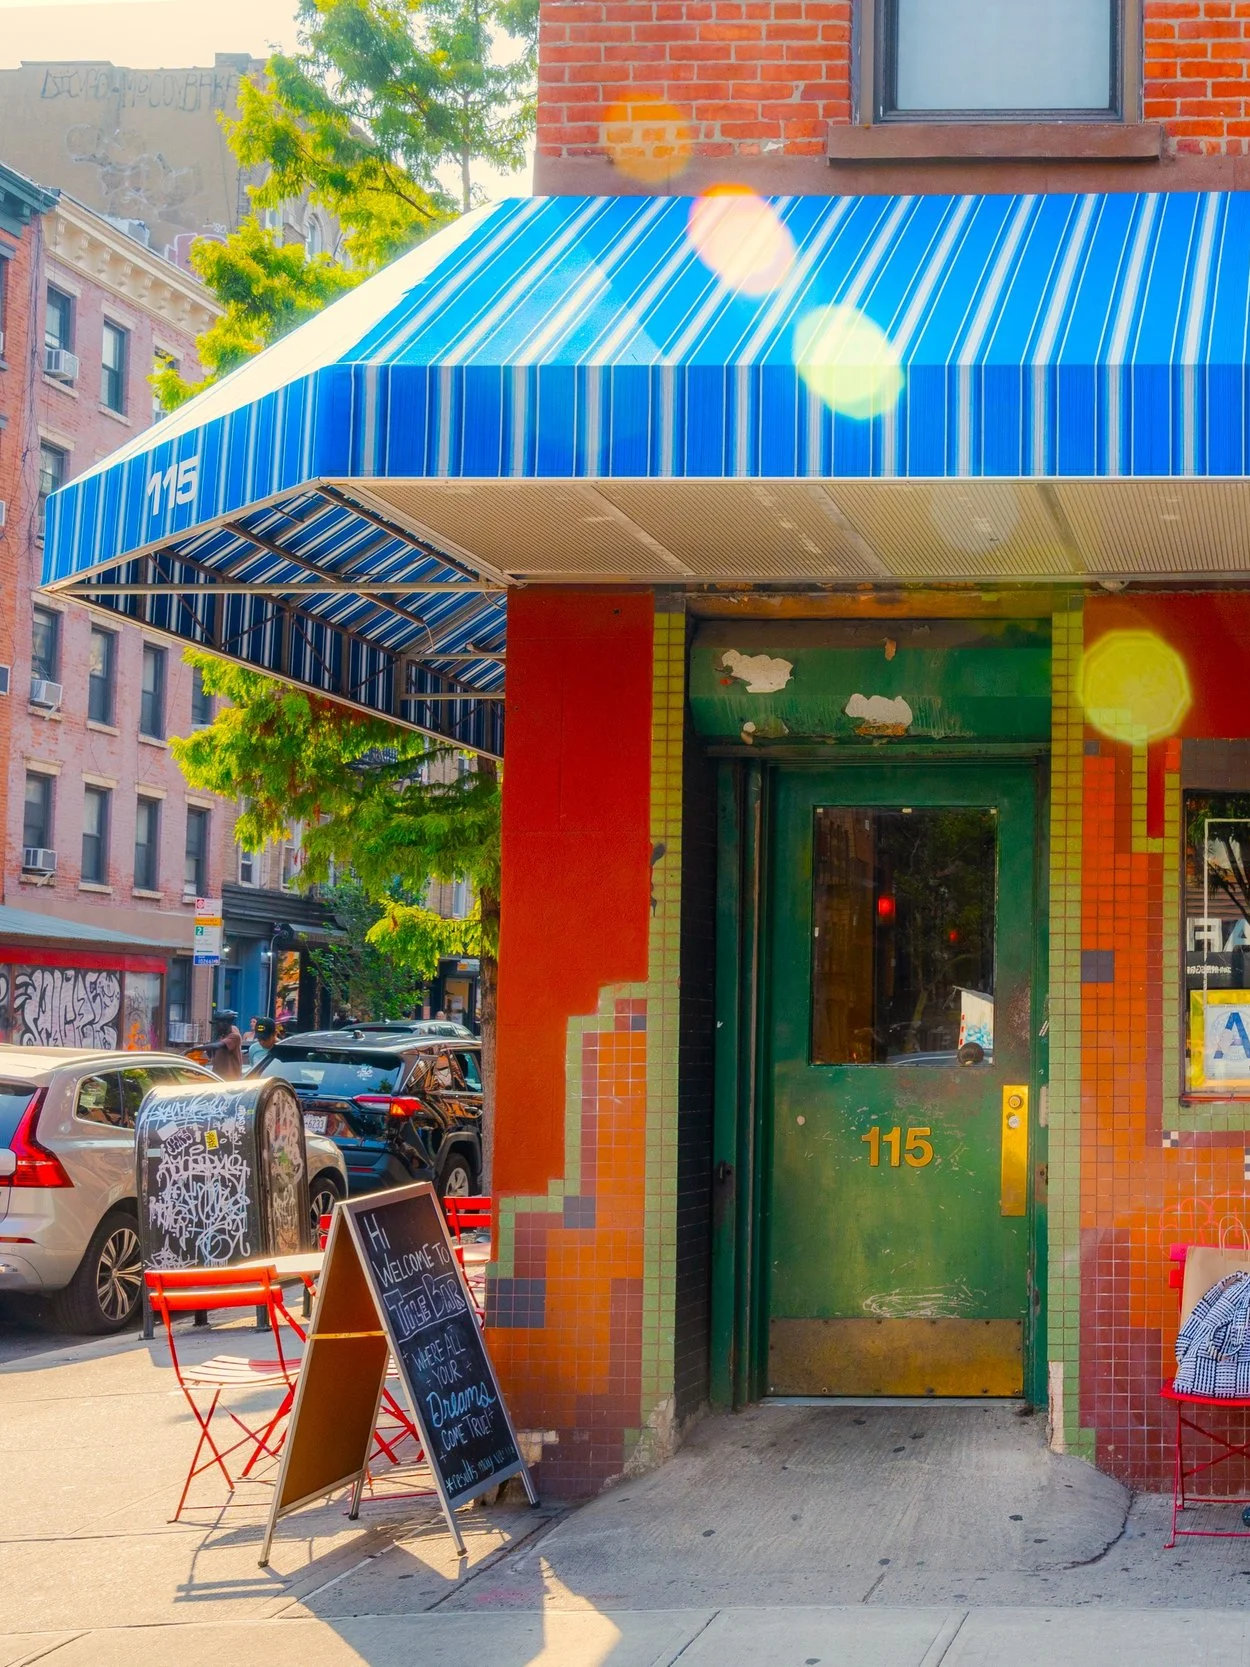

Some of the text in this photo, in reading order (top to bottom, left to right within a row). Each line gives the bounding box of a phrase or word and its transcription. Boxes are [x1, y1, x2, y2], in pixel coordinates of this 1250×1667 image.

[147, 454, 199, 516] 115
[861, 1126, 934, 1167] 115
[372, 1242, 450, 1288] WELCOME TO
[411, 1333, 466, 1372] WHERE ALL
[432, 1360, 463, 1389] YOUR
[441, 1423, 468, 1451] COME
